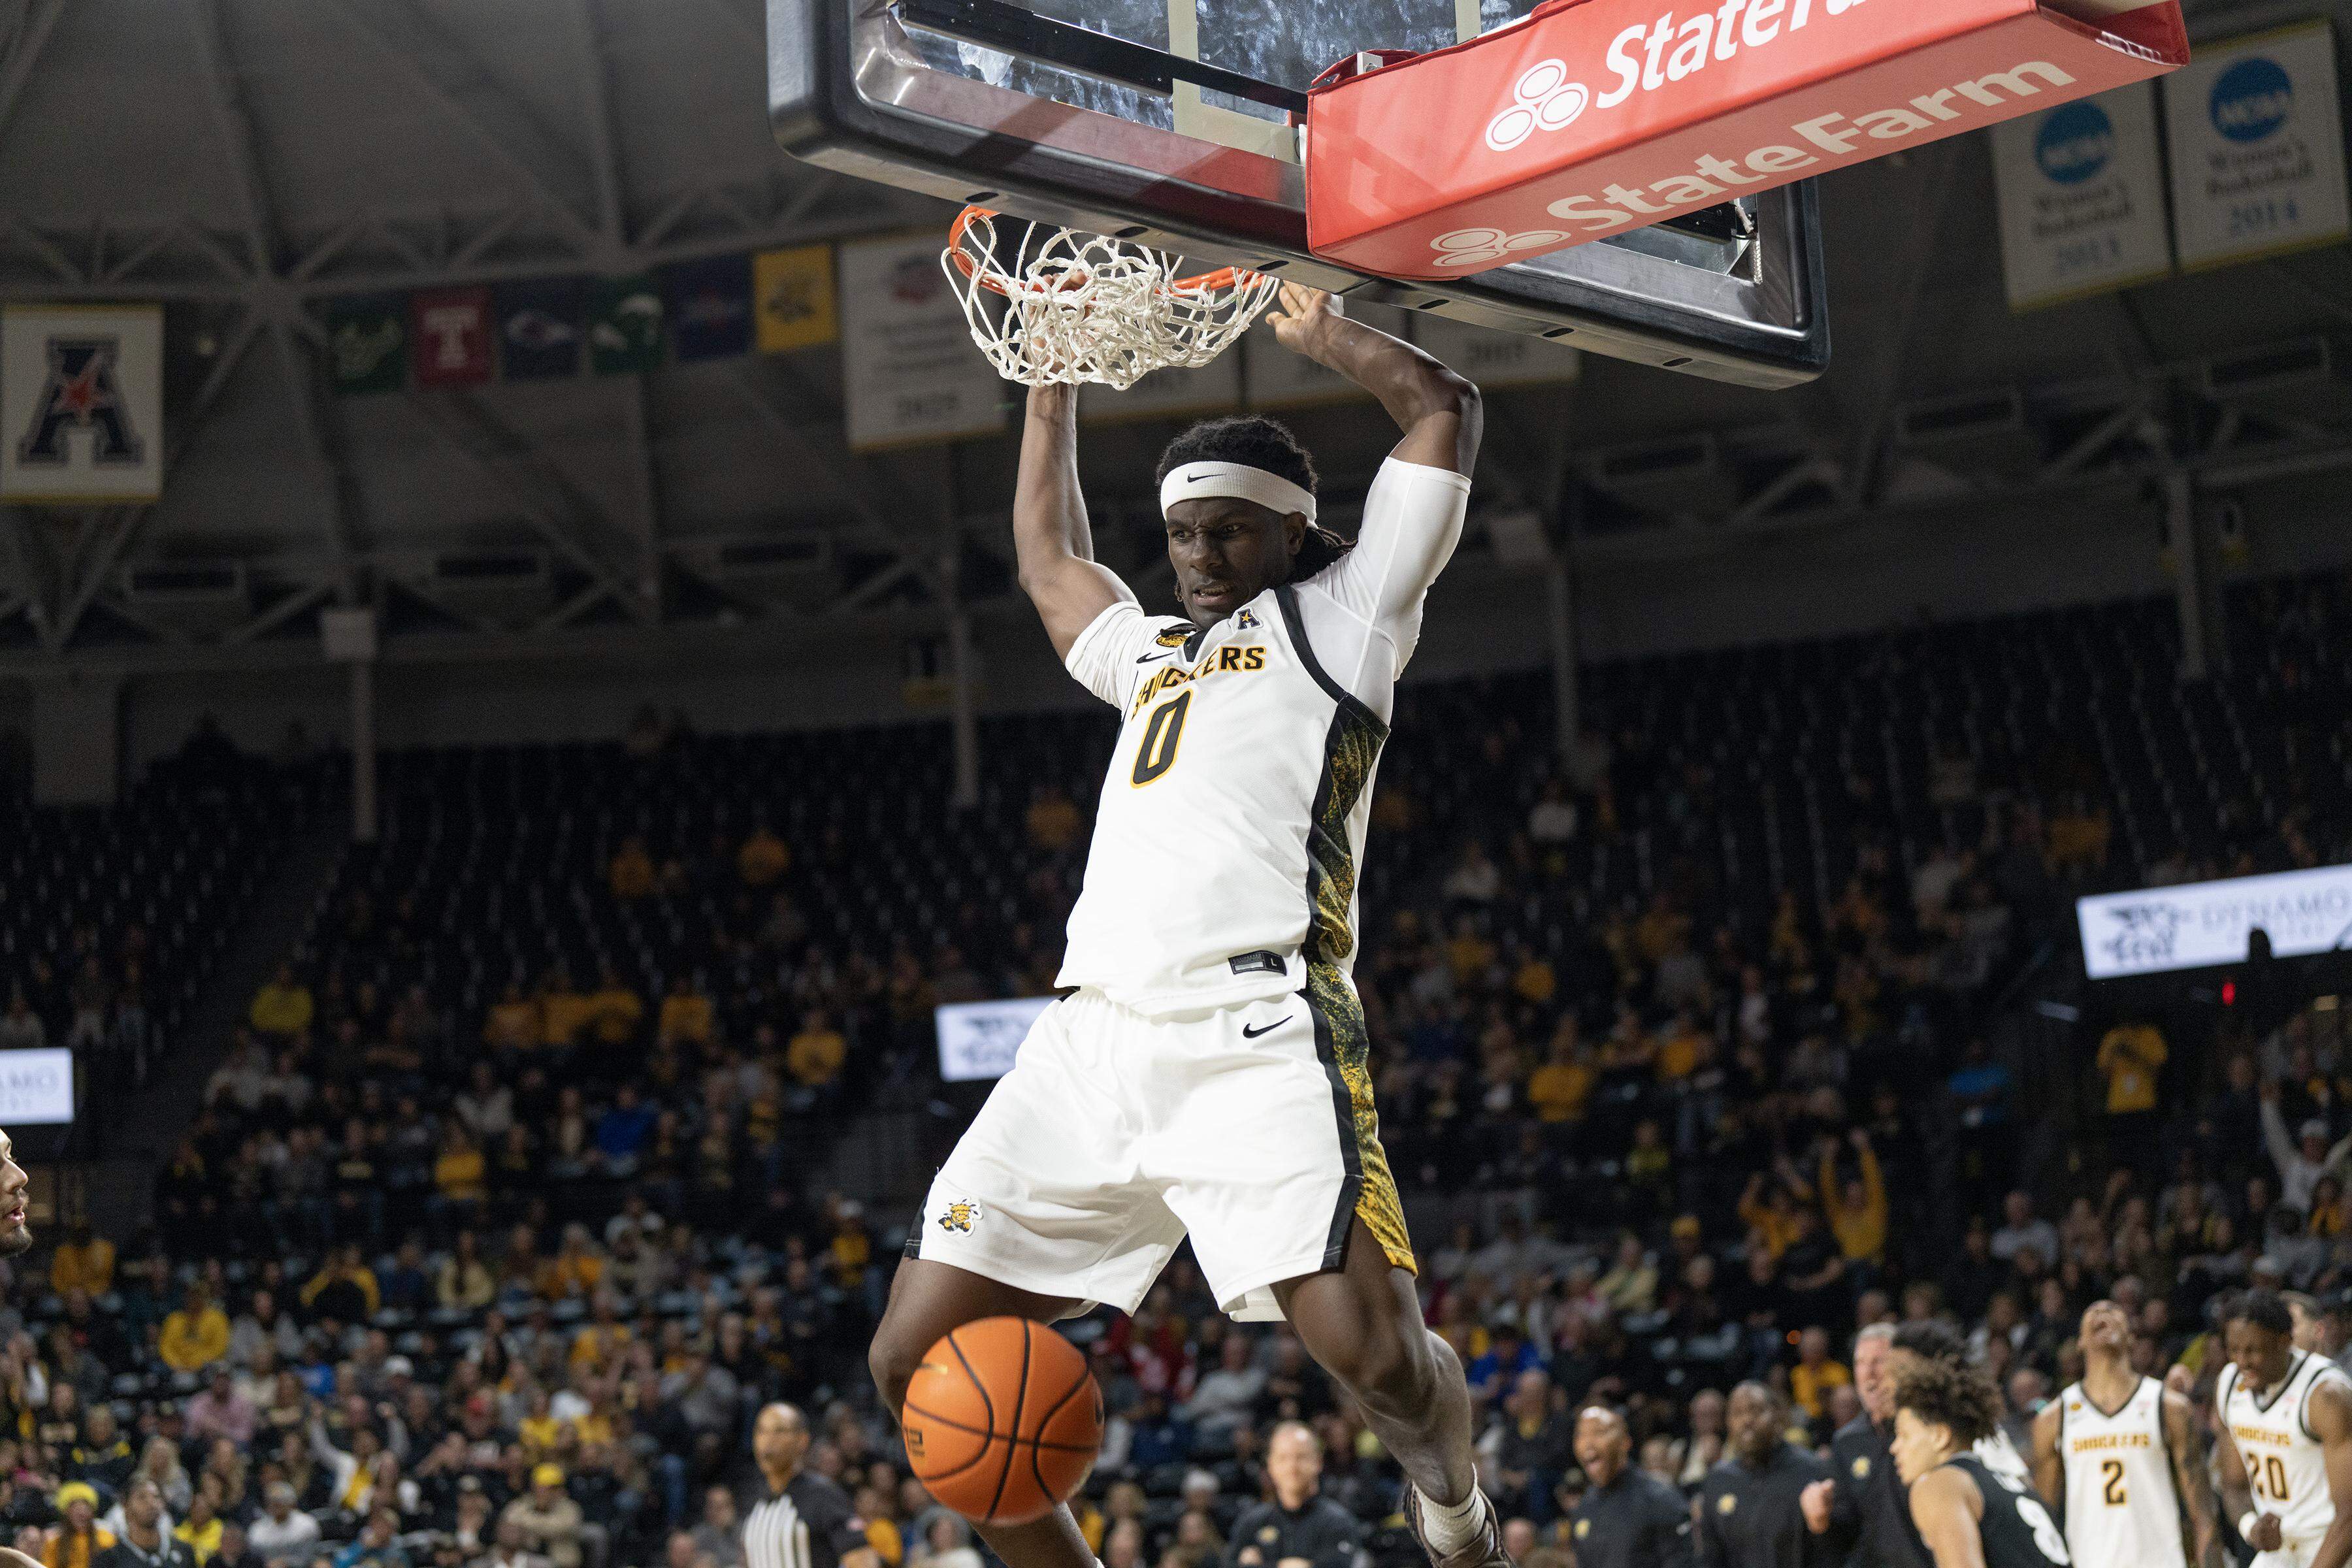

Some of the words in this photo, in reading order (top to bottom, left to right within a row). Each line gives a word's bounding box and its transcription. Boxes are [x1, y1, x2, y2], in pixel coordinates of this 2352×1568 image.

[1596, 0, 1867, 108] State
[1131, 688, 1194, 789] 0
[2102, 1459, 2128, 1505] 2
[2246, 1450, 2291, 1501] 20
